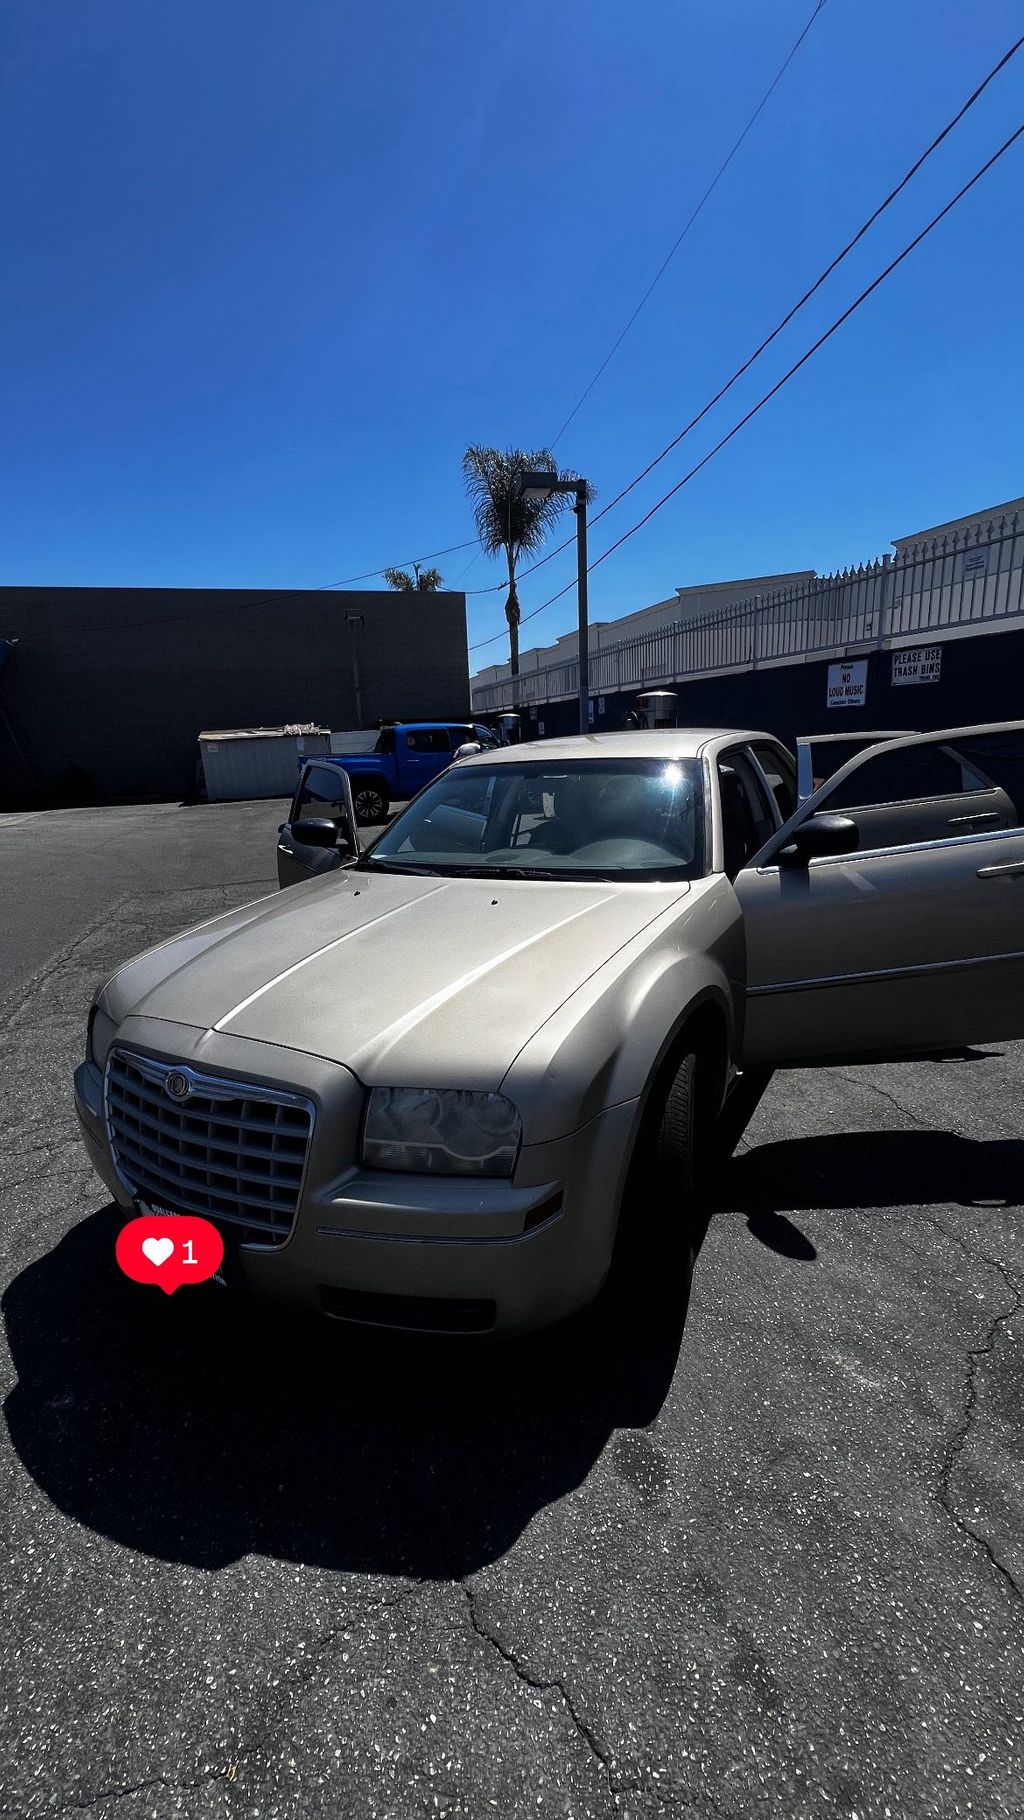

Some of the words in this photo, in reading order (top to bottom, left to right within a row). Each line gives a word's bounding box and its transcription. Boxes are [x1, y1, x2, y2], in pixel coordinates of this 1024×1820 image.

[894, 652, 921, 664] PLEASE
[925, 650, 941, 660] USE
[894, 666, 918, 677] TRASH
[921, 663, 940, 674] BINS
[842, 673, 851, 683] NO
[829, 687, 844, 697] LOUD
[845, 685, 863, 696] MUSIC
